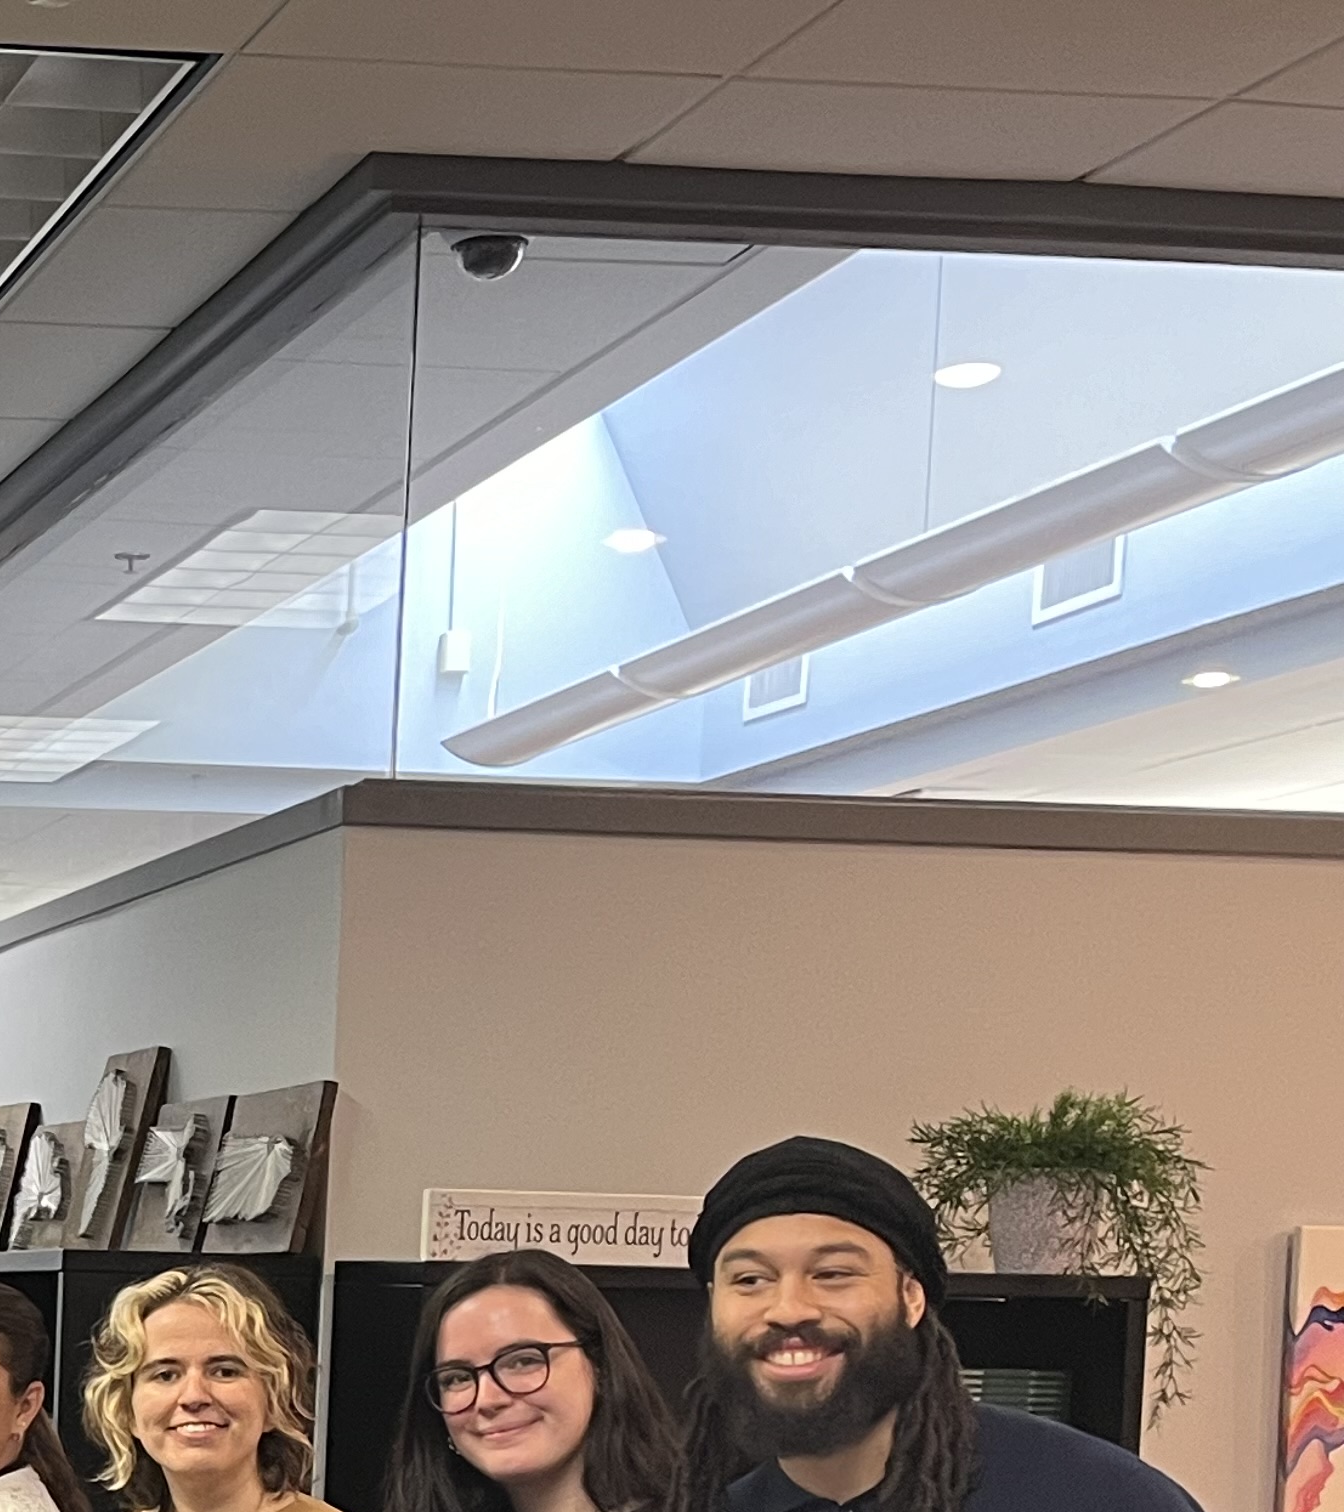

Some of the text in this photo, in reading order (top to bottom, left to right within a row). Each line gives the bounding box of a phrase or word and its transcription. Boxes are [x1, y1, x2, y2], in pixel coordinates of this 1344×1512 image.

[454, 1208, 691, 1258] Today is a good day to
